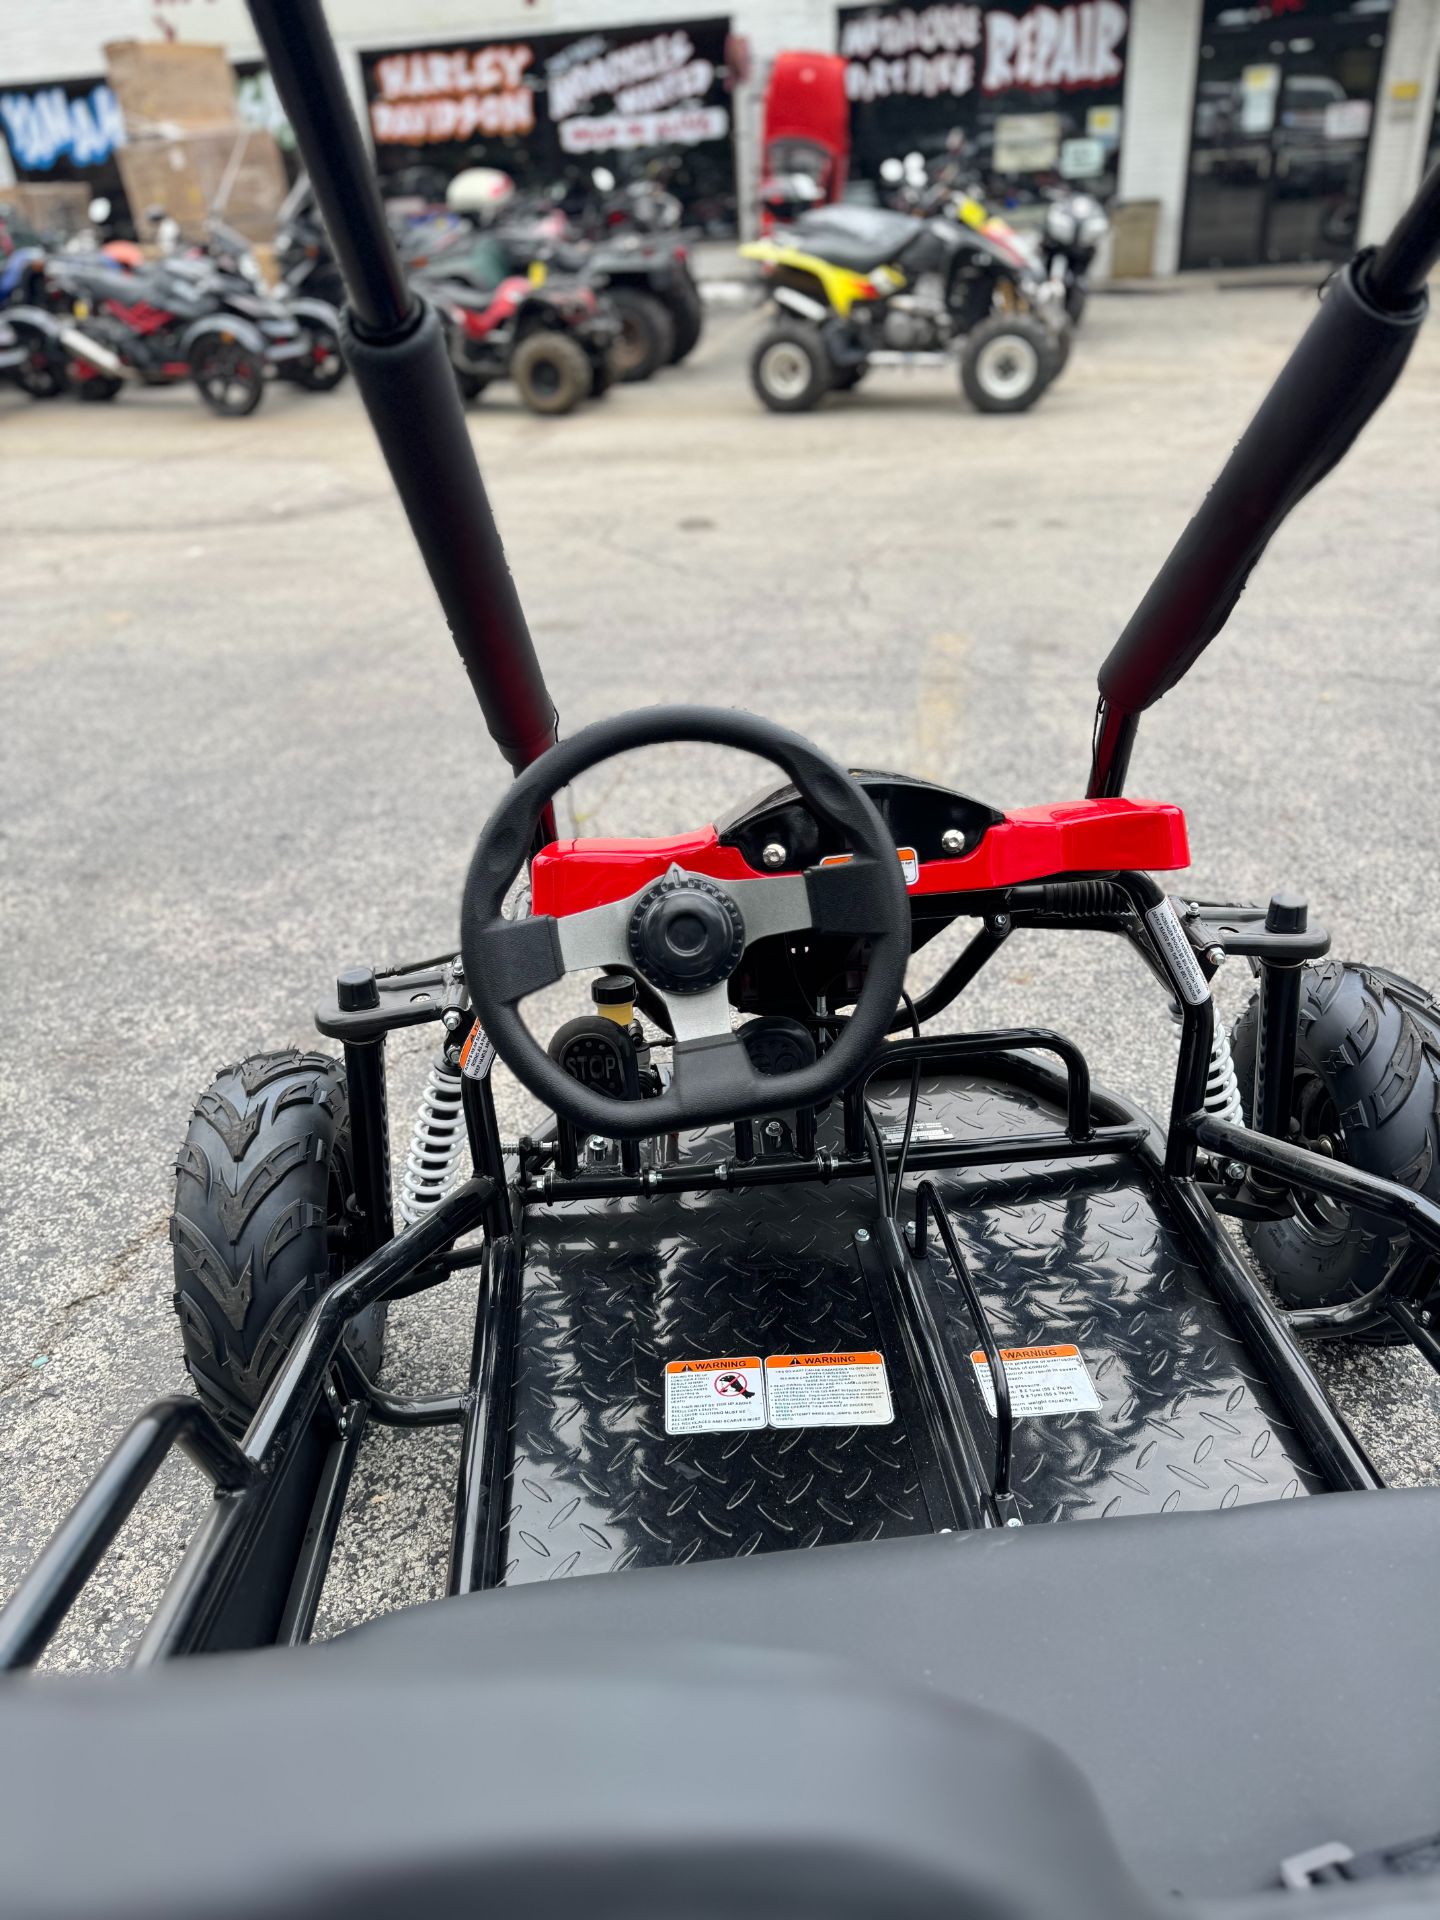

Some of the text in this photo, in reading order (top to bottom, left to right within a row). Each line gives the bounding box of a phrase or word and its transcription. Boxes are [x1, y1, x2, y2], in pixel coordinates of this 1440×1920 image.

[983, 0, 1128, 96] REPAIR
[374, 43, 533, 98] HARLEY
[0, 84, 126, 171] YAMAH
[371, 89, 534, 146] DAVIDSON
[565, 1055, 616, 1080] STOP
[695, 1361, 746, 1370] WARNING
[804, 1356, 855, 1364] WARNING
[1004, 1349, 1057, 1359] WARNING
